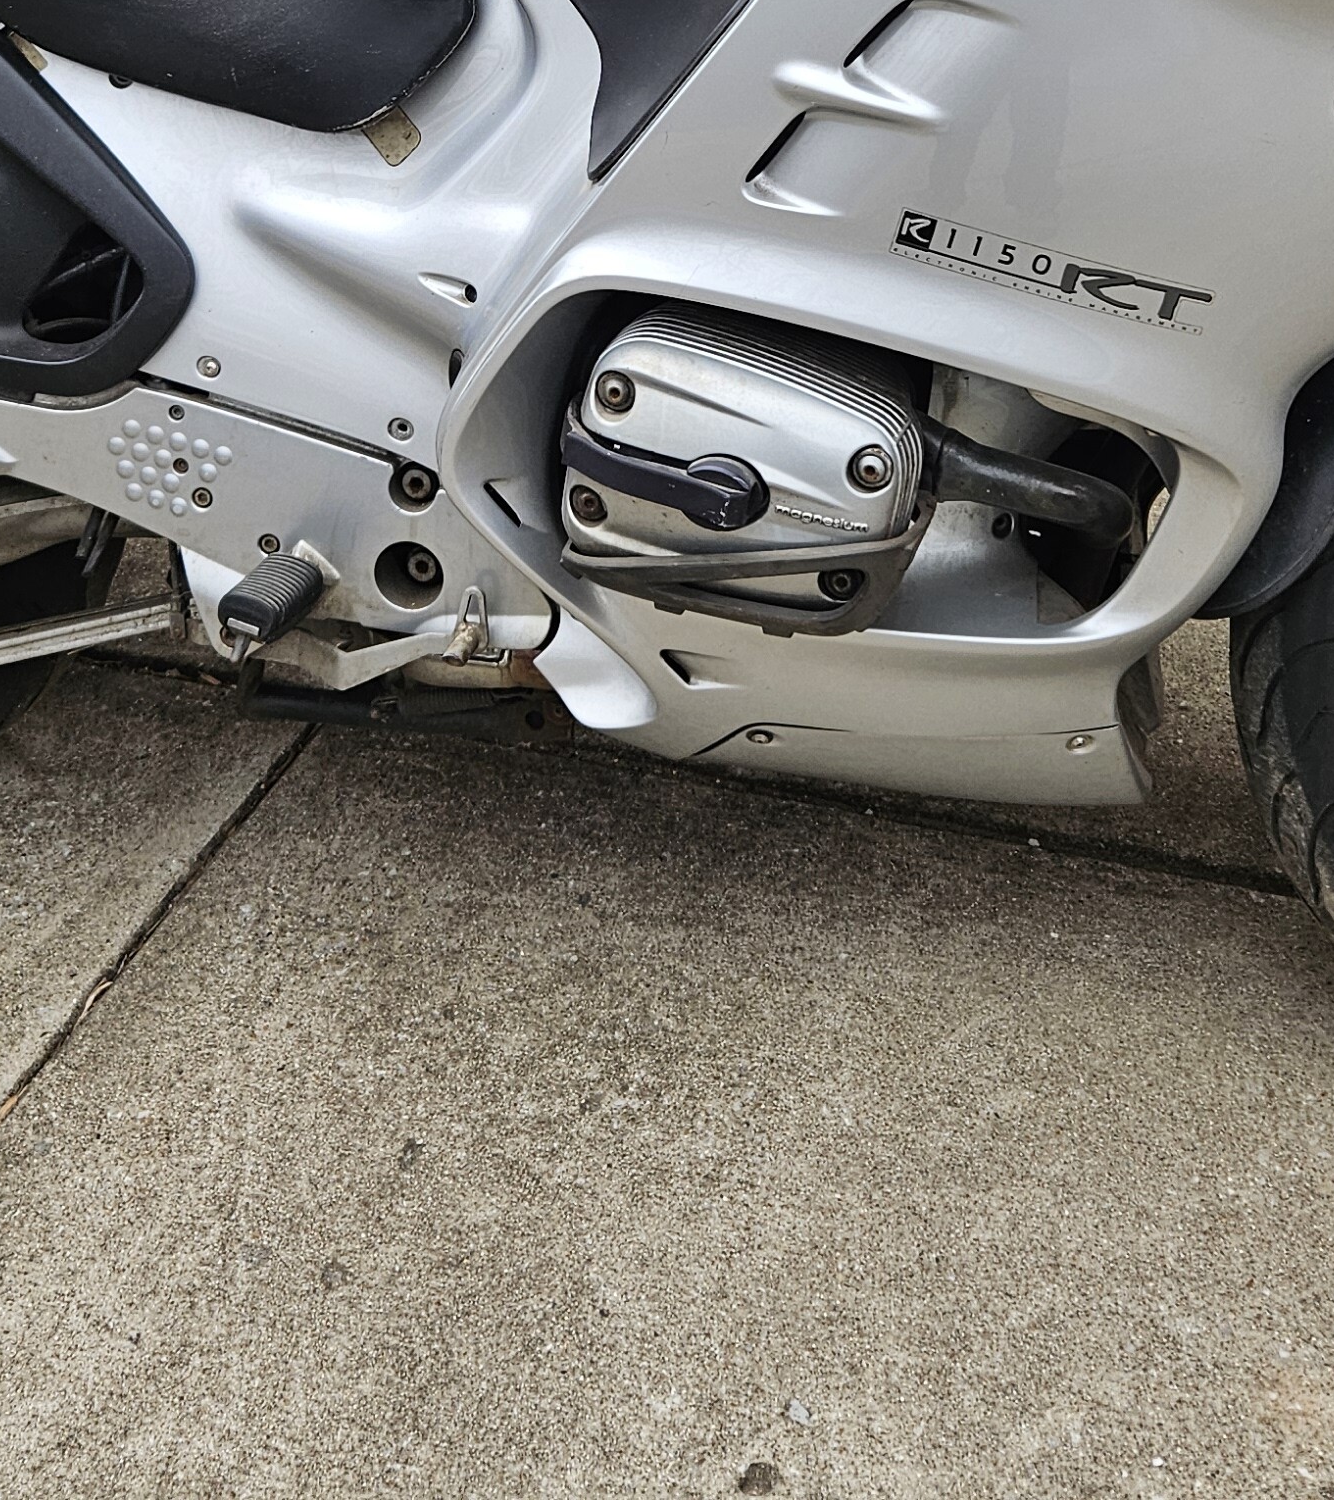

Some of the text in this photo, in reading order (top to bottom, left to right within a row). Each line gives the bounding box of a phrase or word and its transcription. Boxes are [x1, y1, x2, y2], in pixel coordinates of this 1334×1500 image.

[892, 247, 998, 283] ELECTRONIC
[1088, 302, 1199, 333] MANAGEMENT
[774, 504, 869, 534] magnesium
